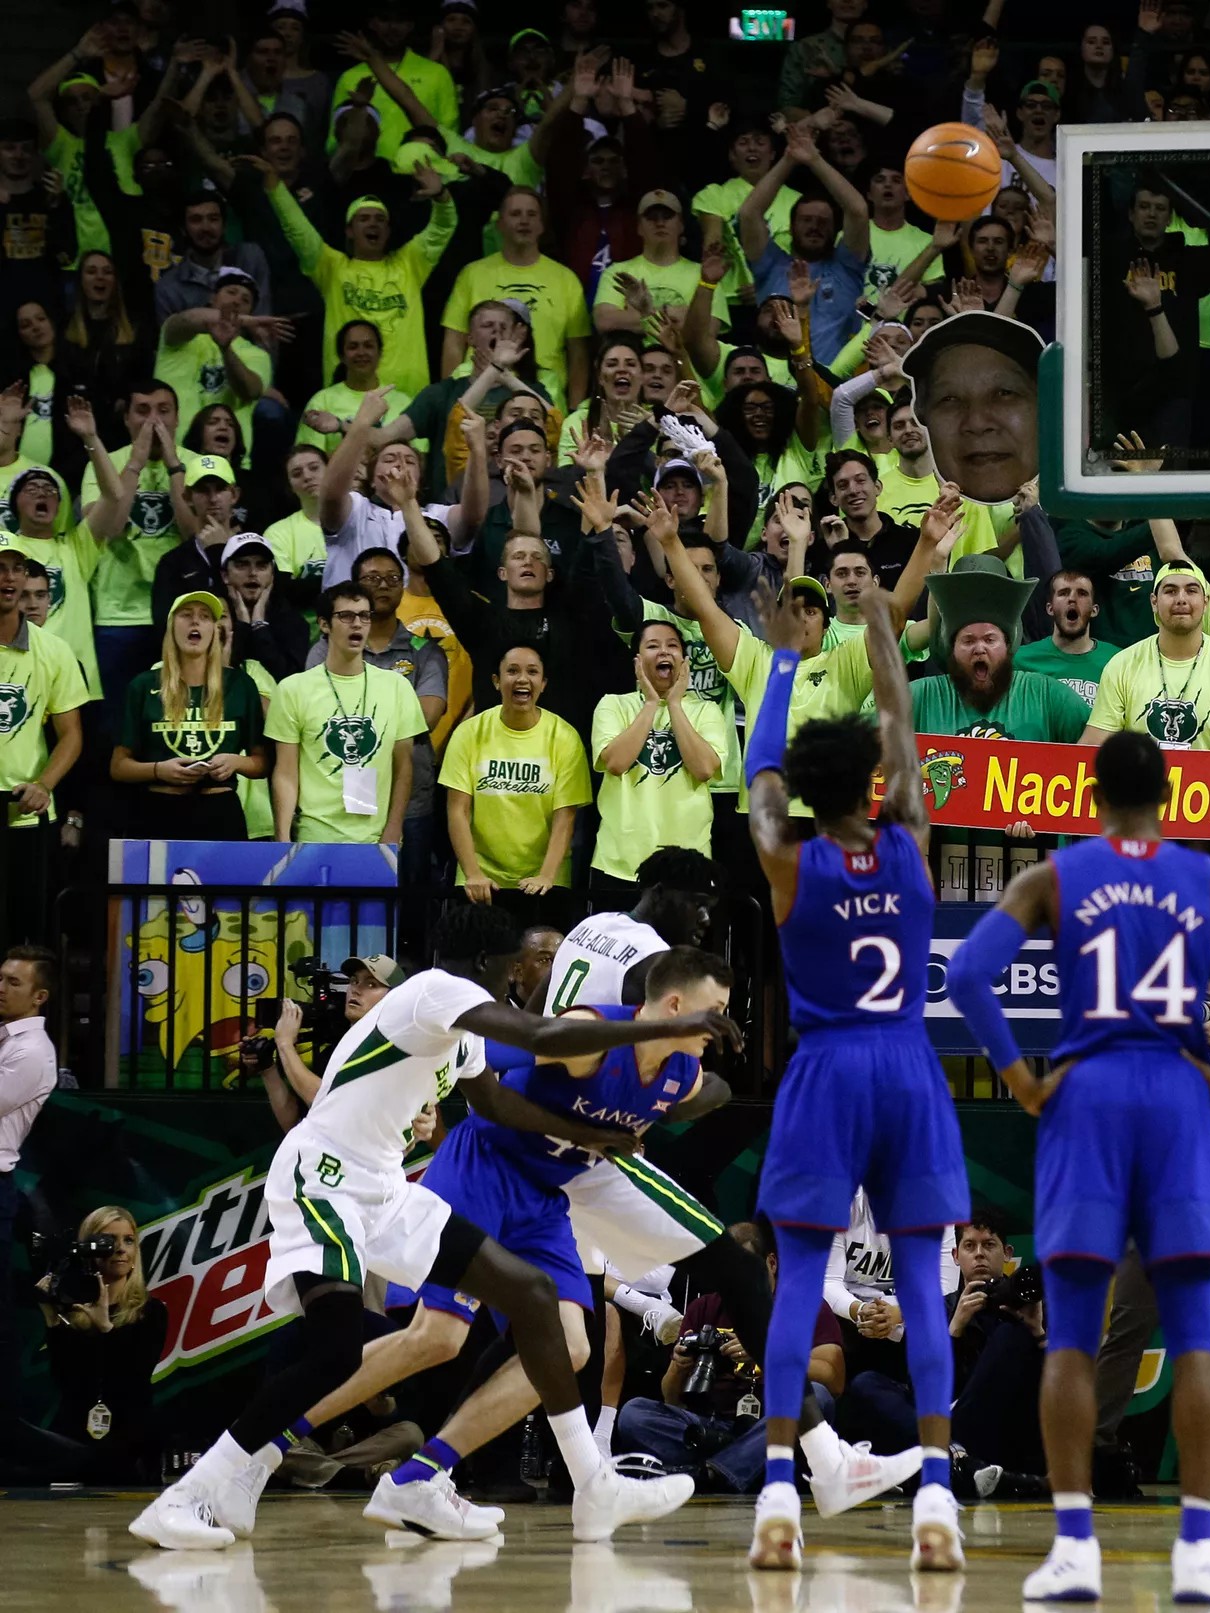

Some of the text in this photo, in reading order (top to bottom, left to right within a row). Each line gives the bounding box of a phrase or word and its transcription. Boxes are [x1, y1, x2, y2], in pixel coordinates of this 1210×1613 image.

[476, 776, 550, 795] Basketball
[488, 759, 541, 784] BAYLOR
[983, 755, 1099, 819] Nach
[833, 892, 901, 921] VICK
[1074, 881, 1204, 933] NEWMAN
[551, 958, 592, 1016] 0
[850, 935, 905, 1013] 2
[1079, 927, 1198, 1025] 14
[314, 1152, 347, 1188] BU
